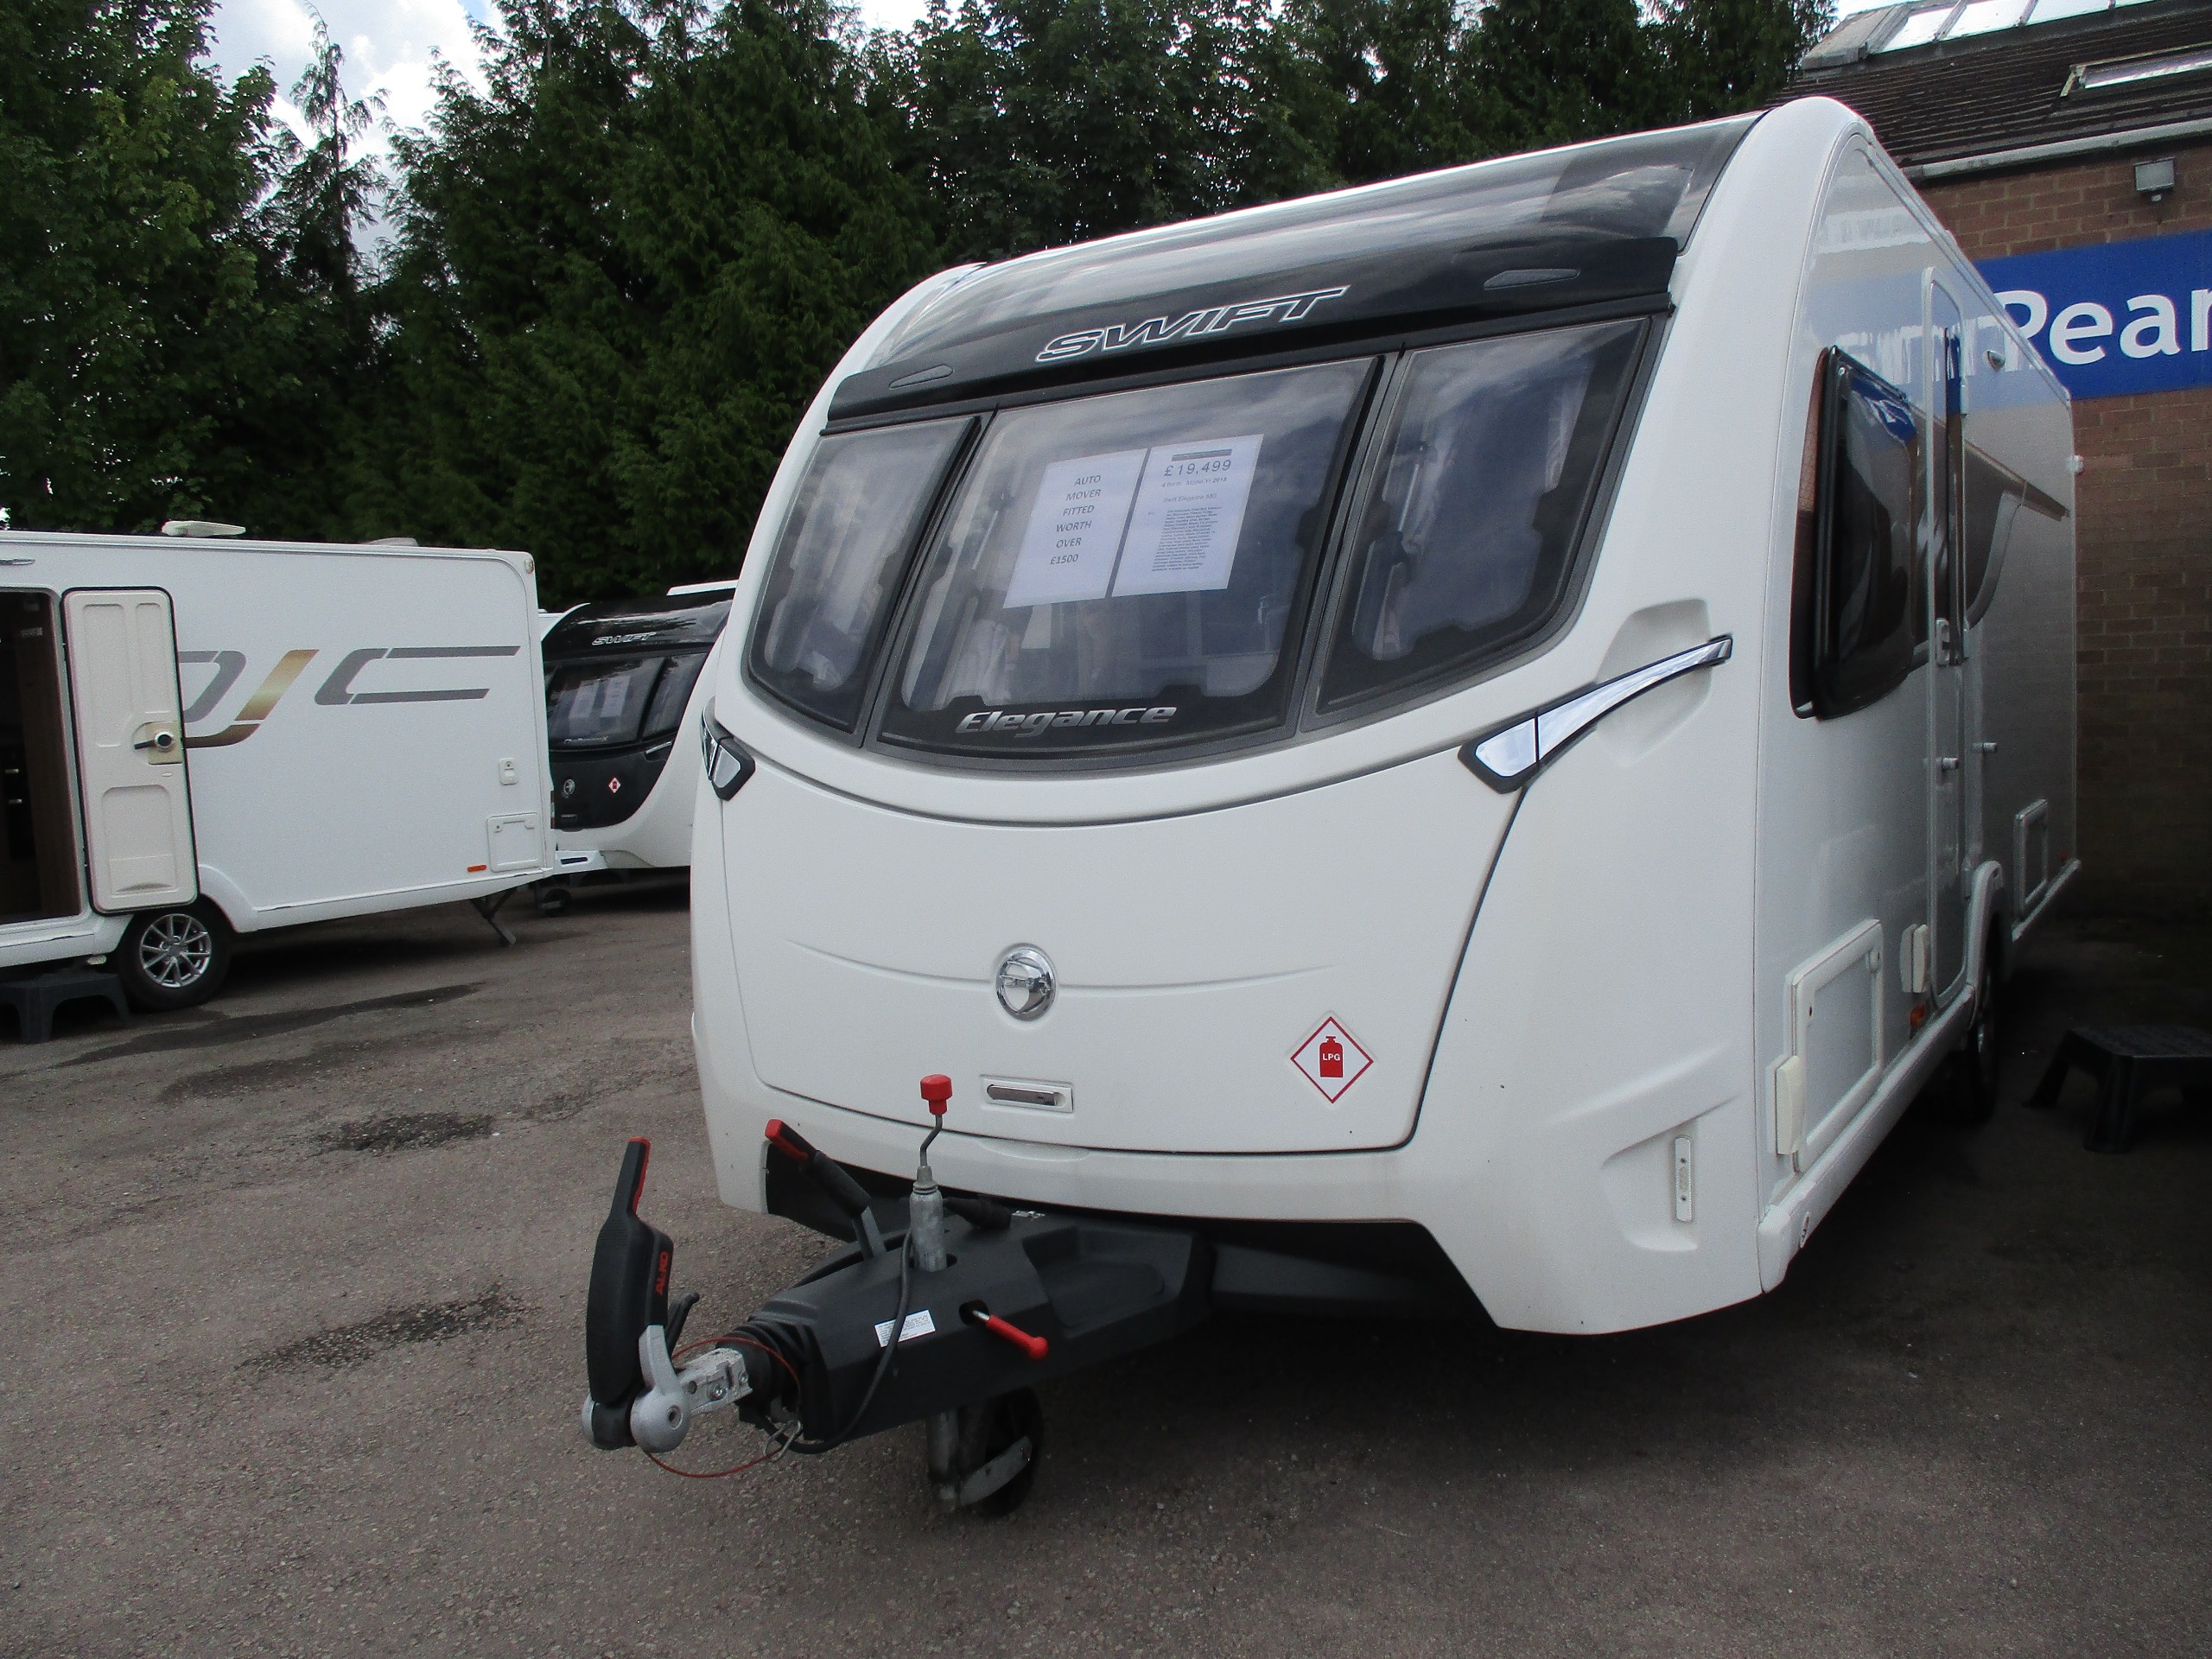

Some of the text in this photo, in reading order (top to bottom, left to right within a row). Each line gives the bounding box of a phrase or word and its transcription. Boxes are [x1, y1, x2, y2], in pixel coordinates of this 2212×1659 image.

[1035, 284, 1351, 363] SWIFT
[1163, 459, 1231, 477] £19,499
[1074, 474, 1102, 486] AUTO
[1065, 488, 1102, 502] MOVER
[1062, 505, 1095, 517] FITTED
[1056, 520, 1092, 533] WORTH
[1056, 537, 1082, 549] OVER
[1049, 554, 1079, 566] £1500
[591, 631, 657, 646] SWIFT
[955, 706, 1178, 738] Elegance
[1322, 1052, 1341, 1061] LPG
